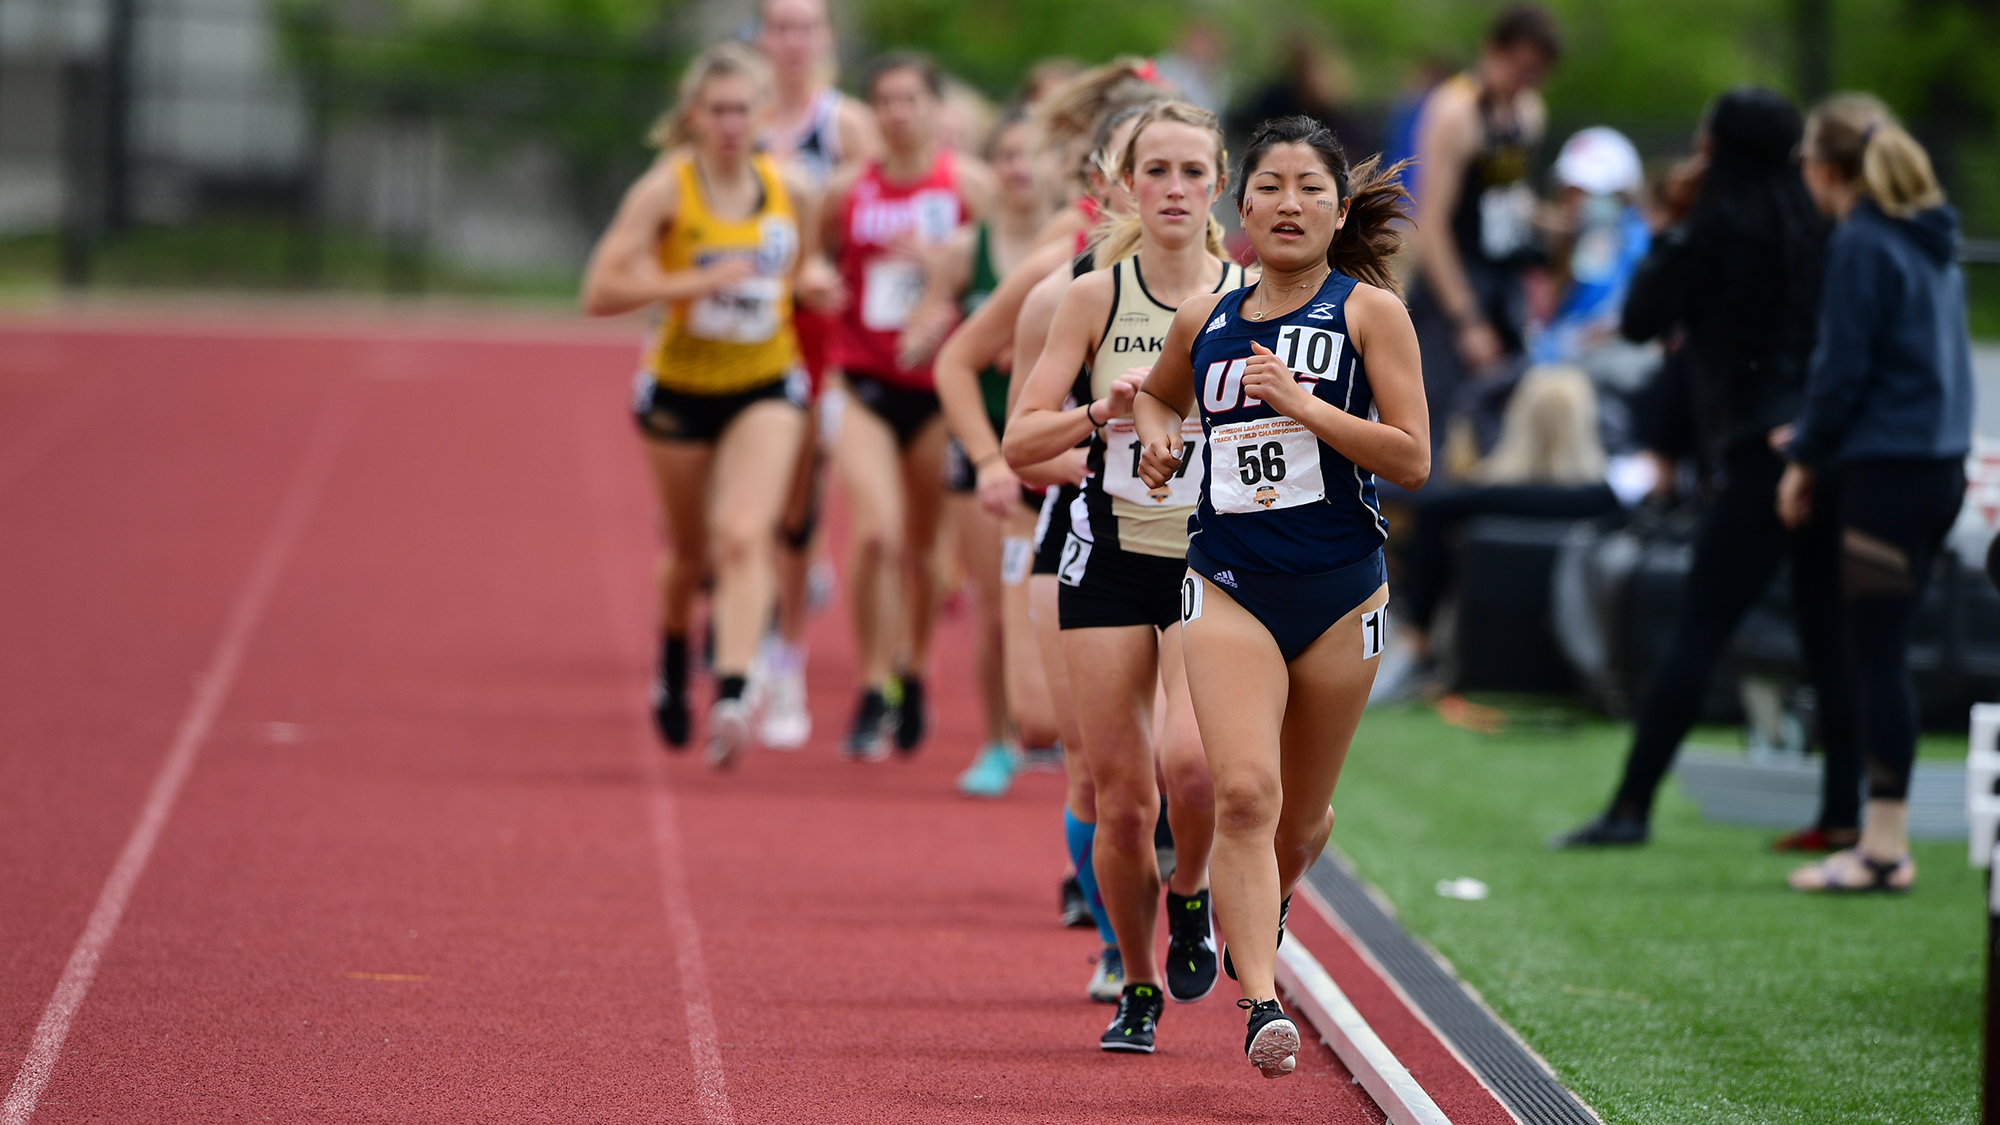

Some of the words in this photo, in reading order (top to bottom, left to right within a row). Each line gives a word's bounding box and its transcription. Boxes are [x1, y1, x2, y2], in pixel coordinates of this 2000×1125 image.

[1283, 327, 1333, 374] 10
[1213, 436, 1232, 444] TRACK
[1239, 432, 1257, 441] FIELD
[1258, 426, 1308, 438] CHAMPIONSHI
[1218, 427, 1243, 437] HORIZON
[1244, 423, 1269, 432] LEAGUE
[1271, 419, 1303, 430] OUTDOO
[1128, 440, 1196, 478] 17
[1237, 441, 1287, 486] 56
[1061, 540, 1081, 582] 2
[1213, 574, 1238, 588] adidas
